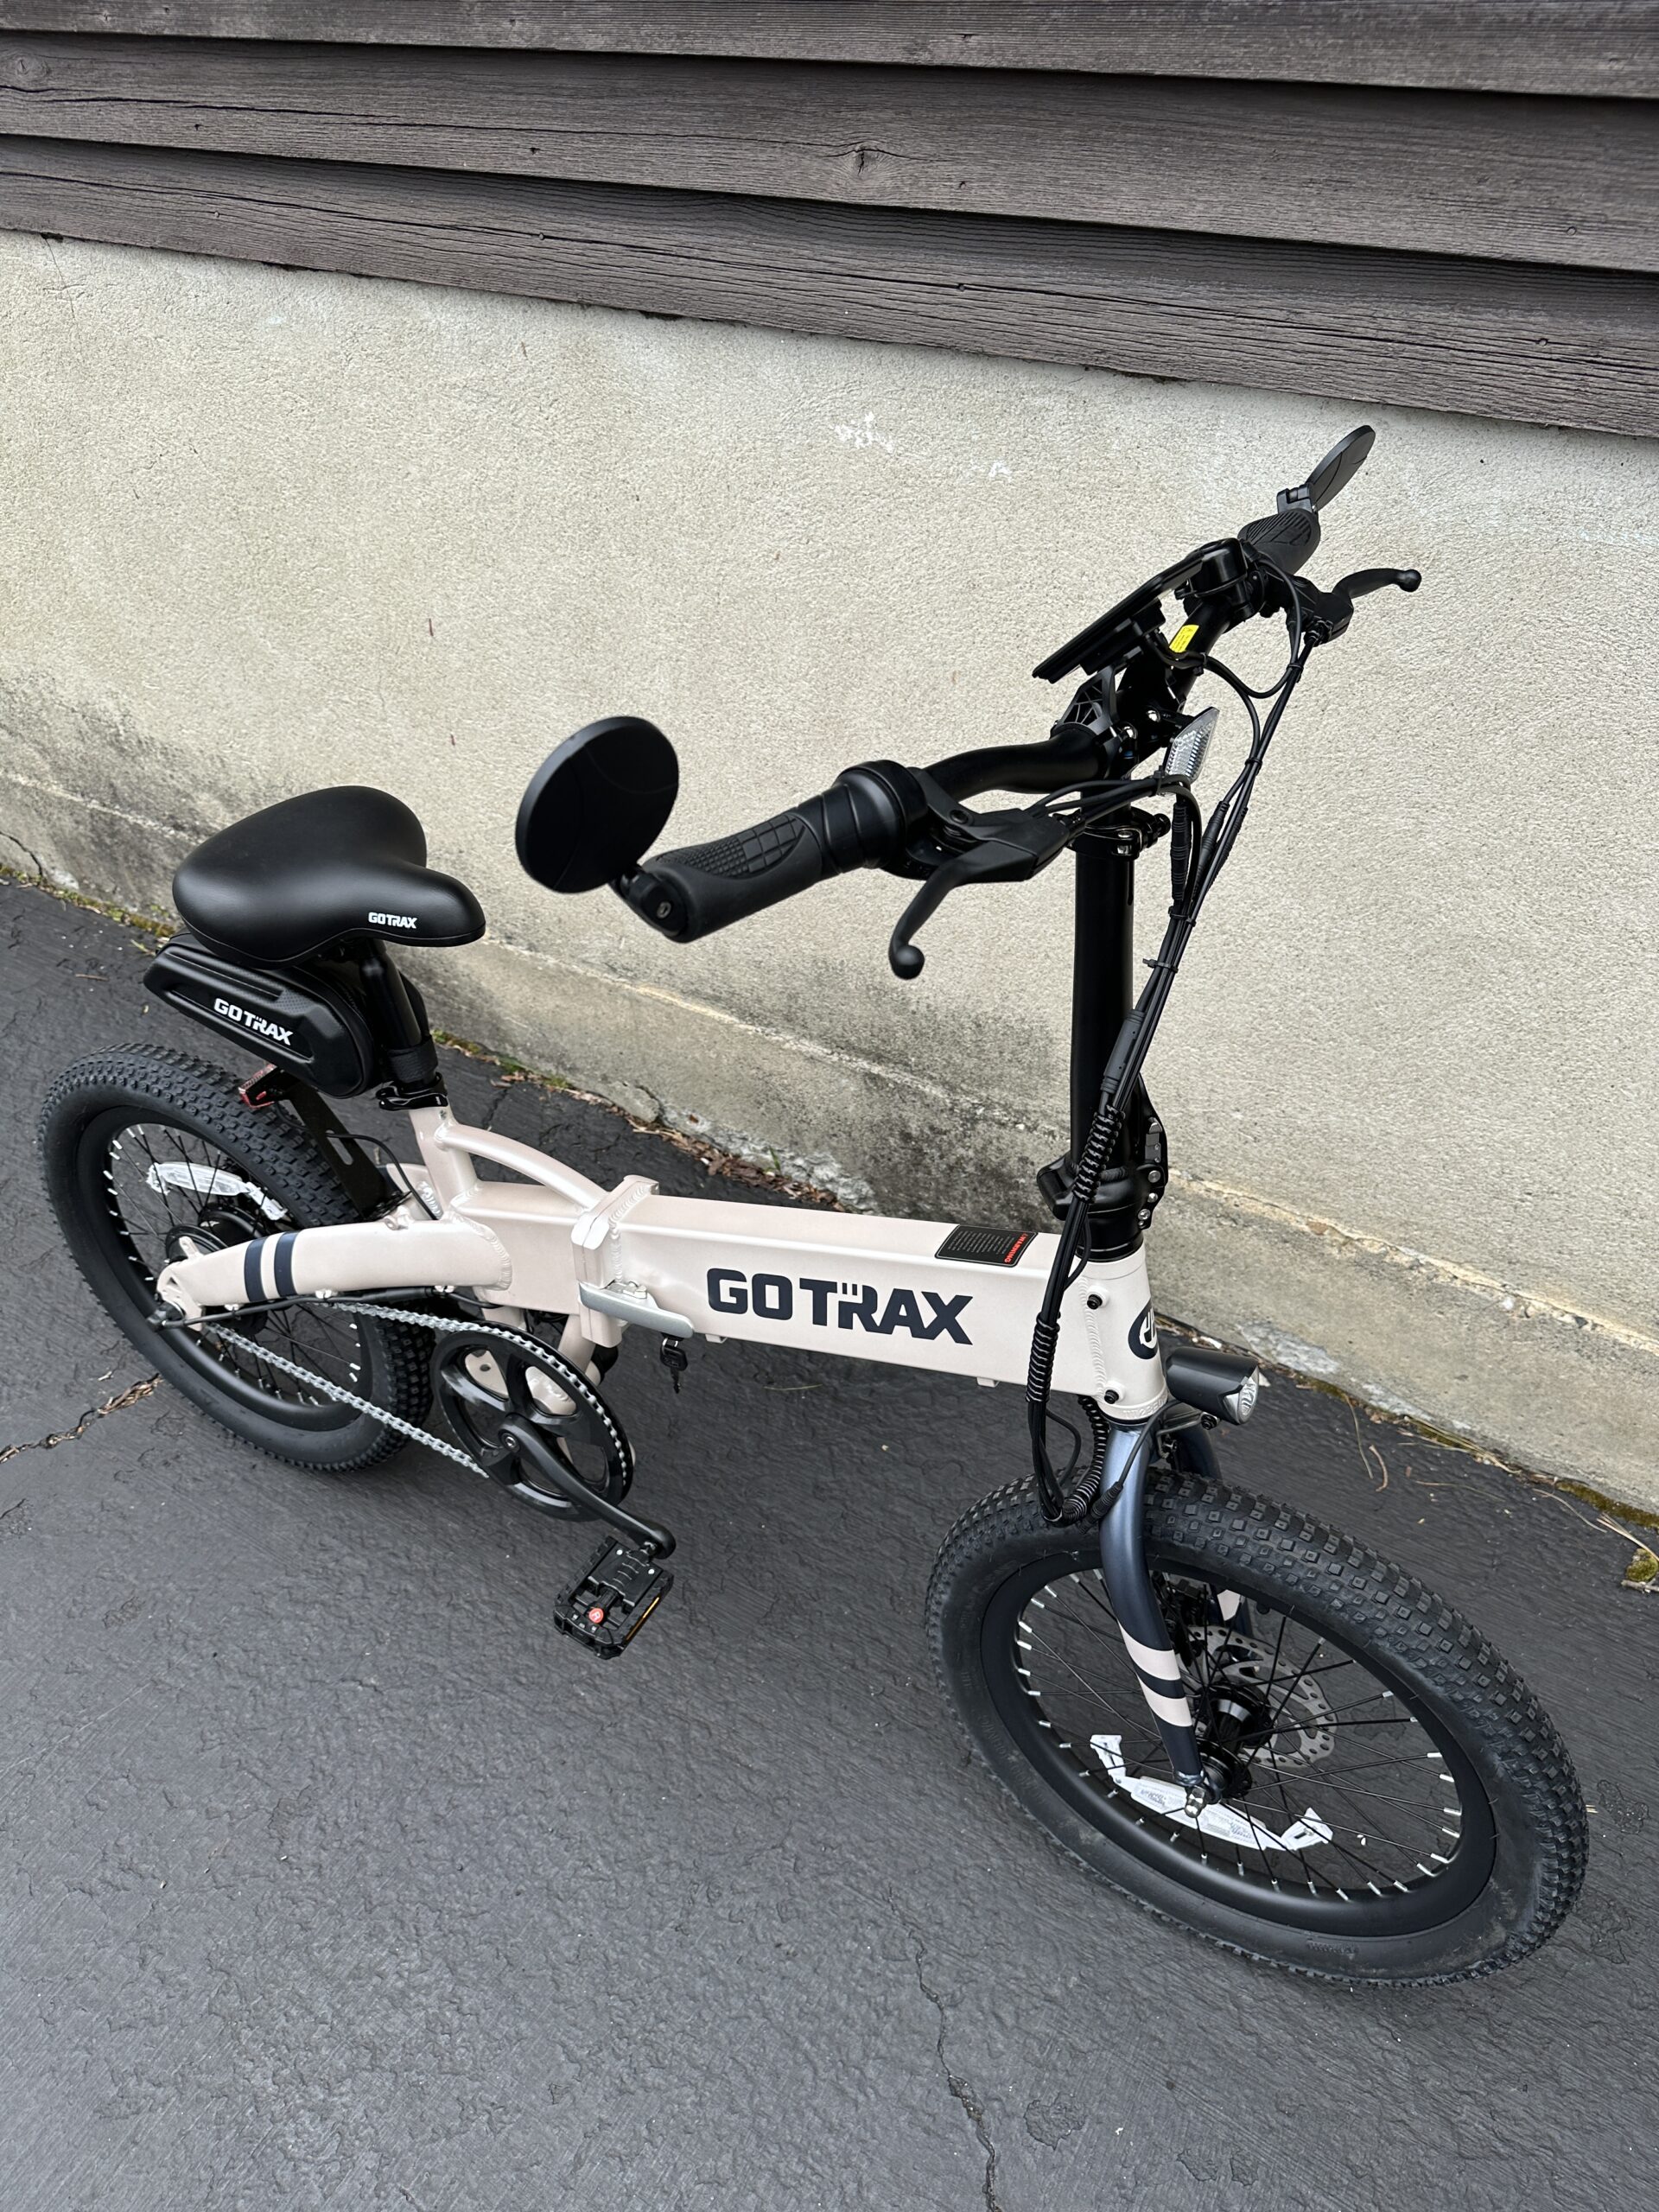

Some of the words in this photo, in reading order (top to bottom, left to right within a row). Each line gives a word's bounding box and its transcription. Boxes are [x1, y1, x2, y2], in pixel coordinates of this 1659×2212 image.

[367, 912, 418, 929] GOTRAX
[213, 998, 294, 1046] GOTRAX
[707, 1268, 974, 1345] GOTRAX
